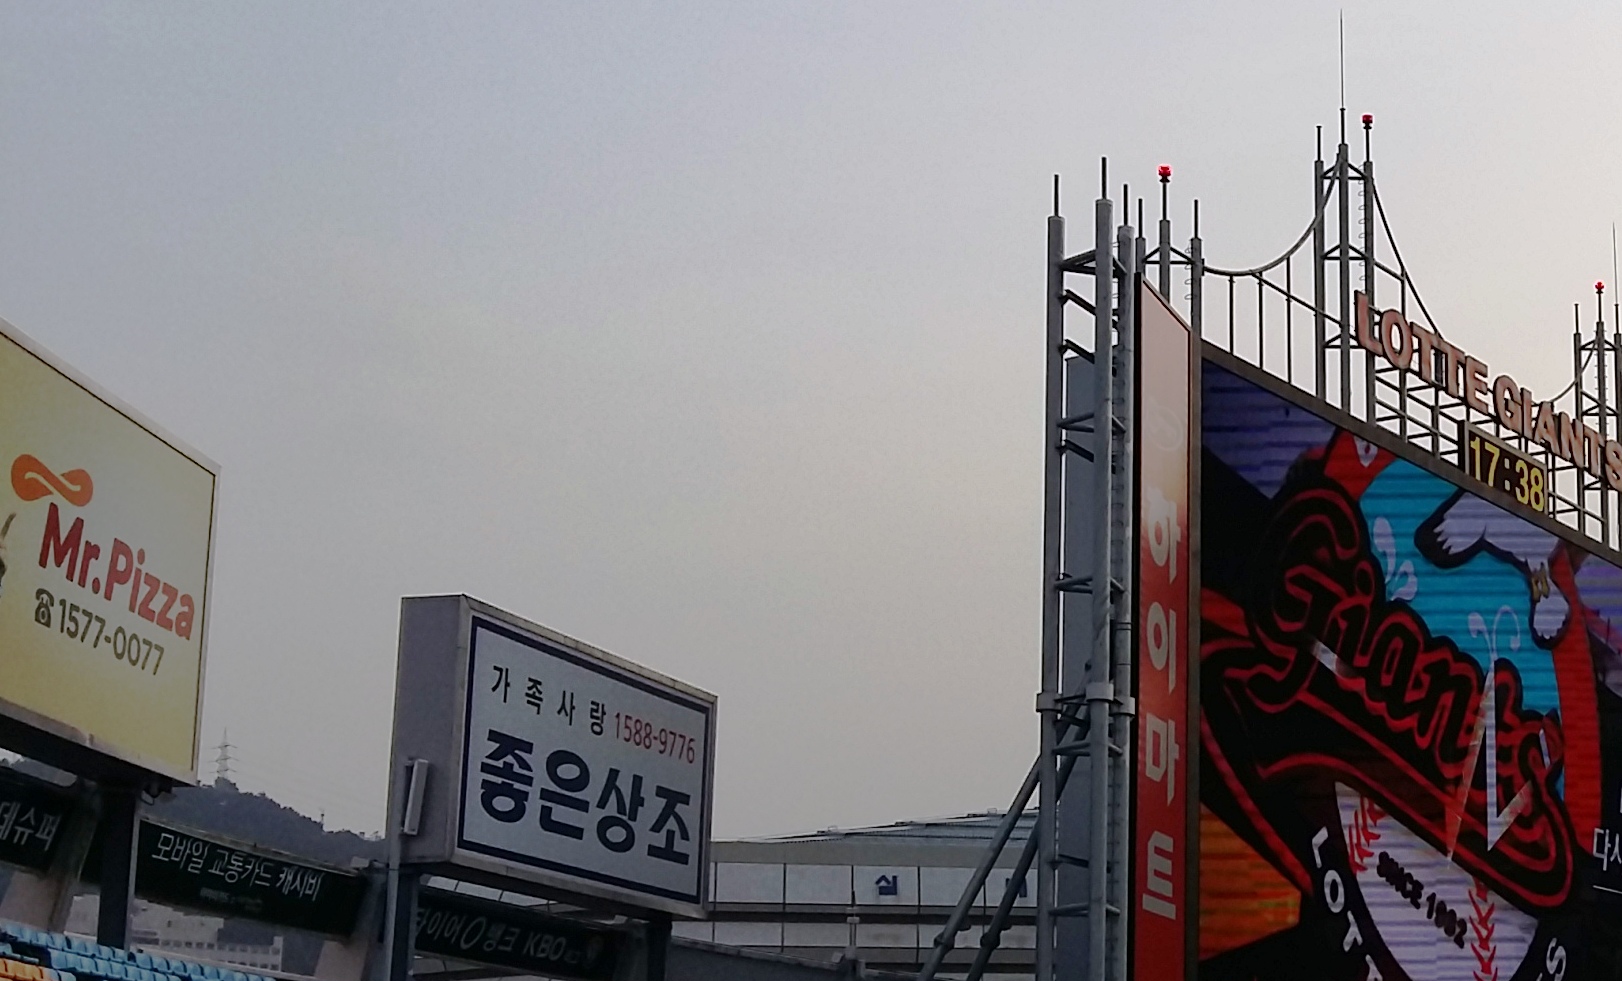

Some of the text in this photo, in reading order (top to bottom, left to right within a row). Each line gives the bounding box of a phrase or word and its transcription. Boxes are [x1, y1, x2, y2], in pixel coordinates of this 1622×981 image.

[1354, 289, 1488, 415] LOTTE
[1470, 436, 1545, 513] 17:38
[59, 598, 165, 676] 1577-0077
[614, 711, 696, 765] 1588-9776
[1142, 487, 1181, 921] 하이마트
[480, 728, 692, 866] 좋은상조
[151, 832, 210, 875] 모바일
[207, 848, 274, 888] 교통카드
[275, 861, 327, 902] 캐시비
